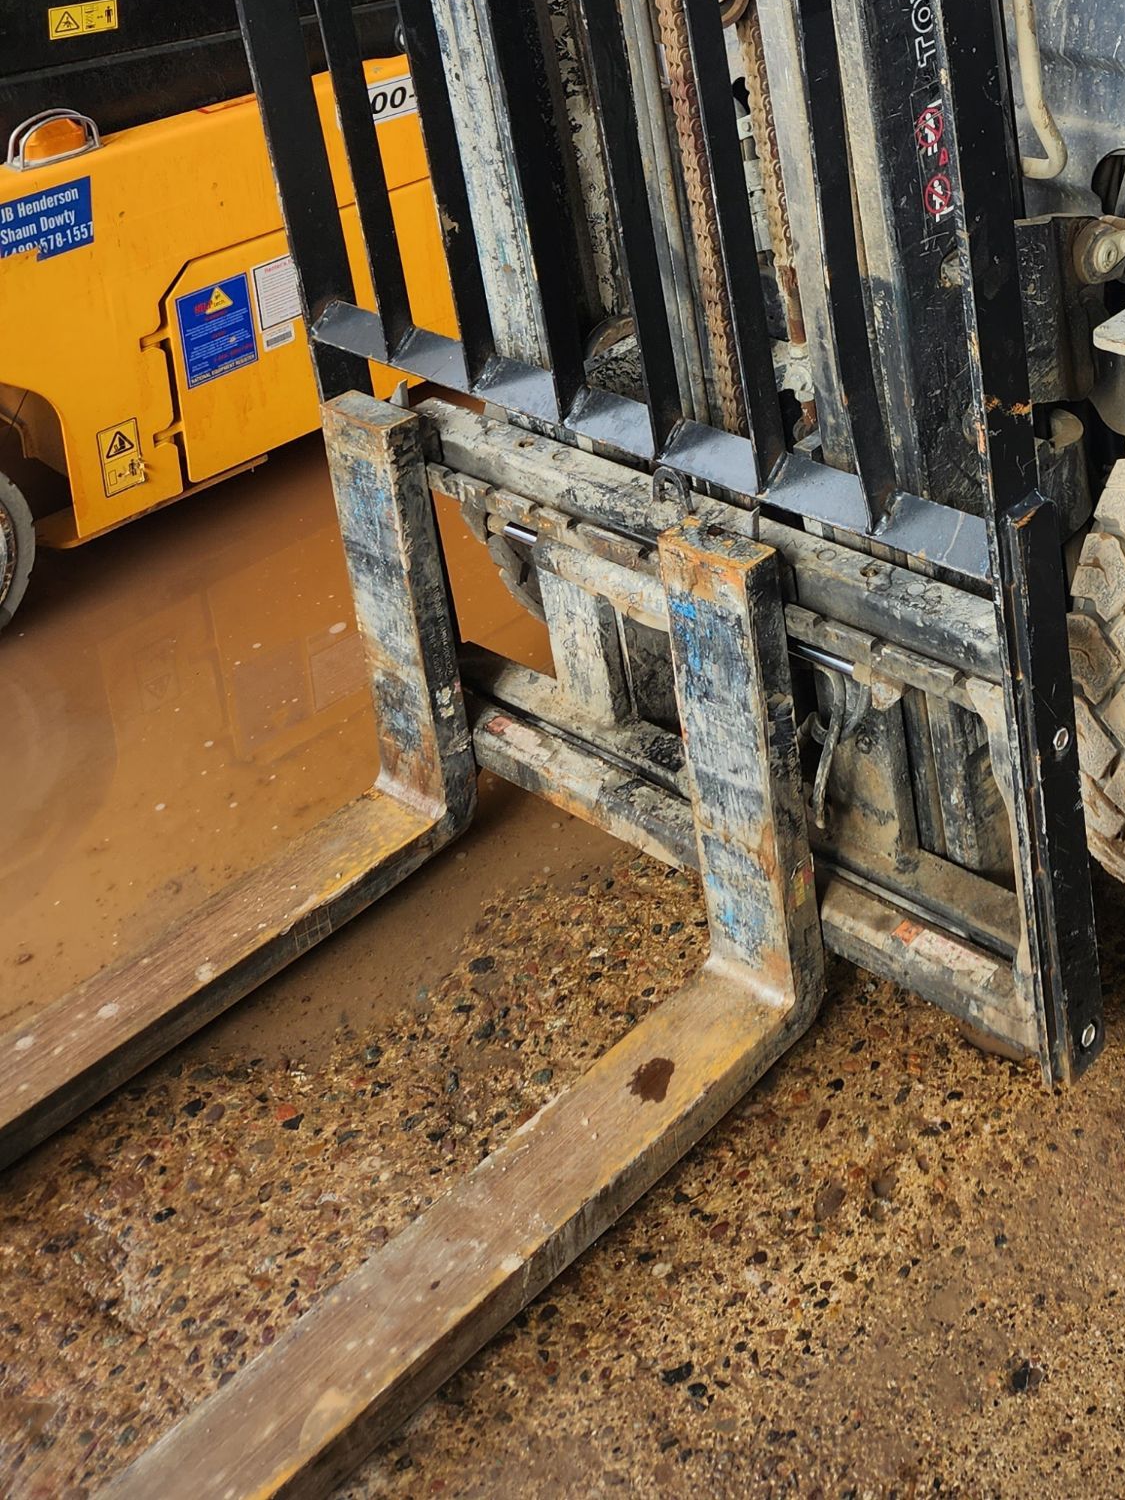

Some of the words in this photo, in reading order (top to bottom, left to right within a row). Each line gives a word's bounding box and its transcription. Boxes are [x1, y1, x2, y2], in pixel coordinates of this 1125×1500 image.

[0, 206, 14, 224] JB
[17, 188, 79, 218] Henderson
[0, 223, 37, 245] Shaun
[40, 210, 75, 232] Dowty
